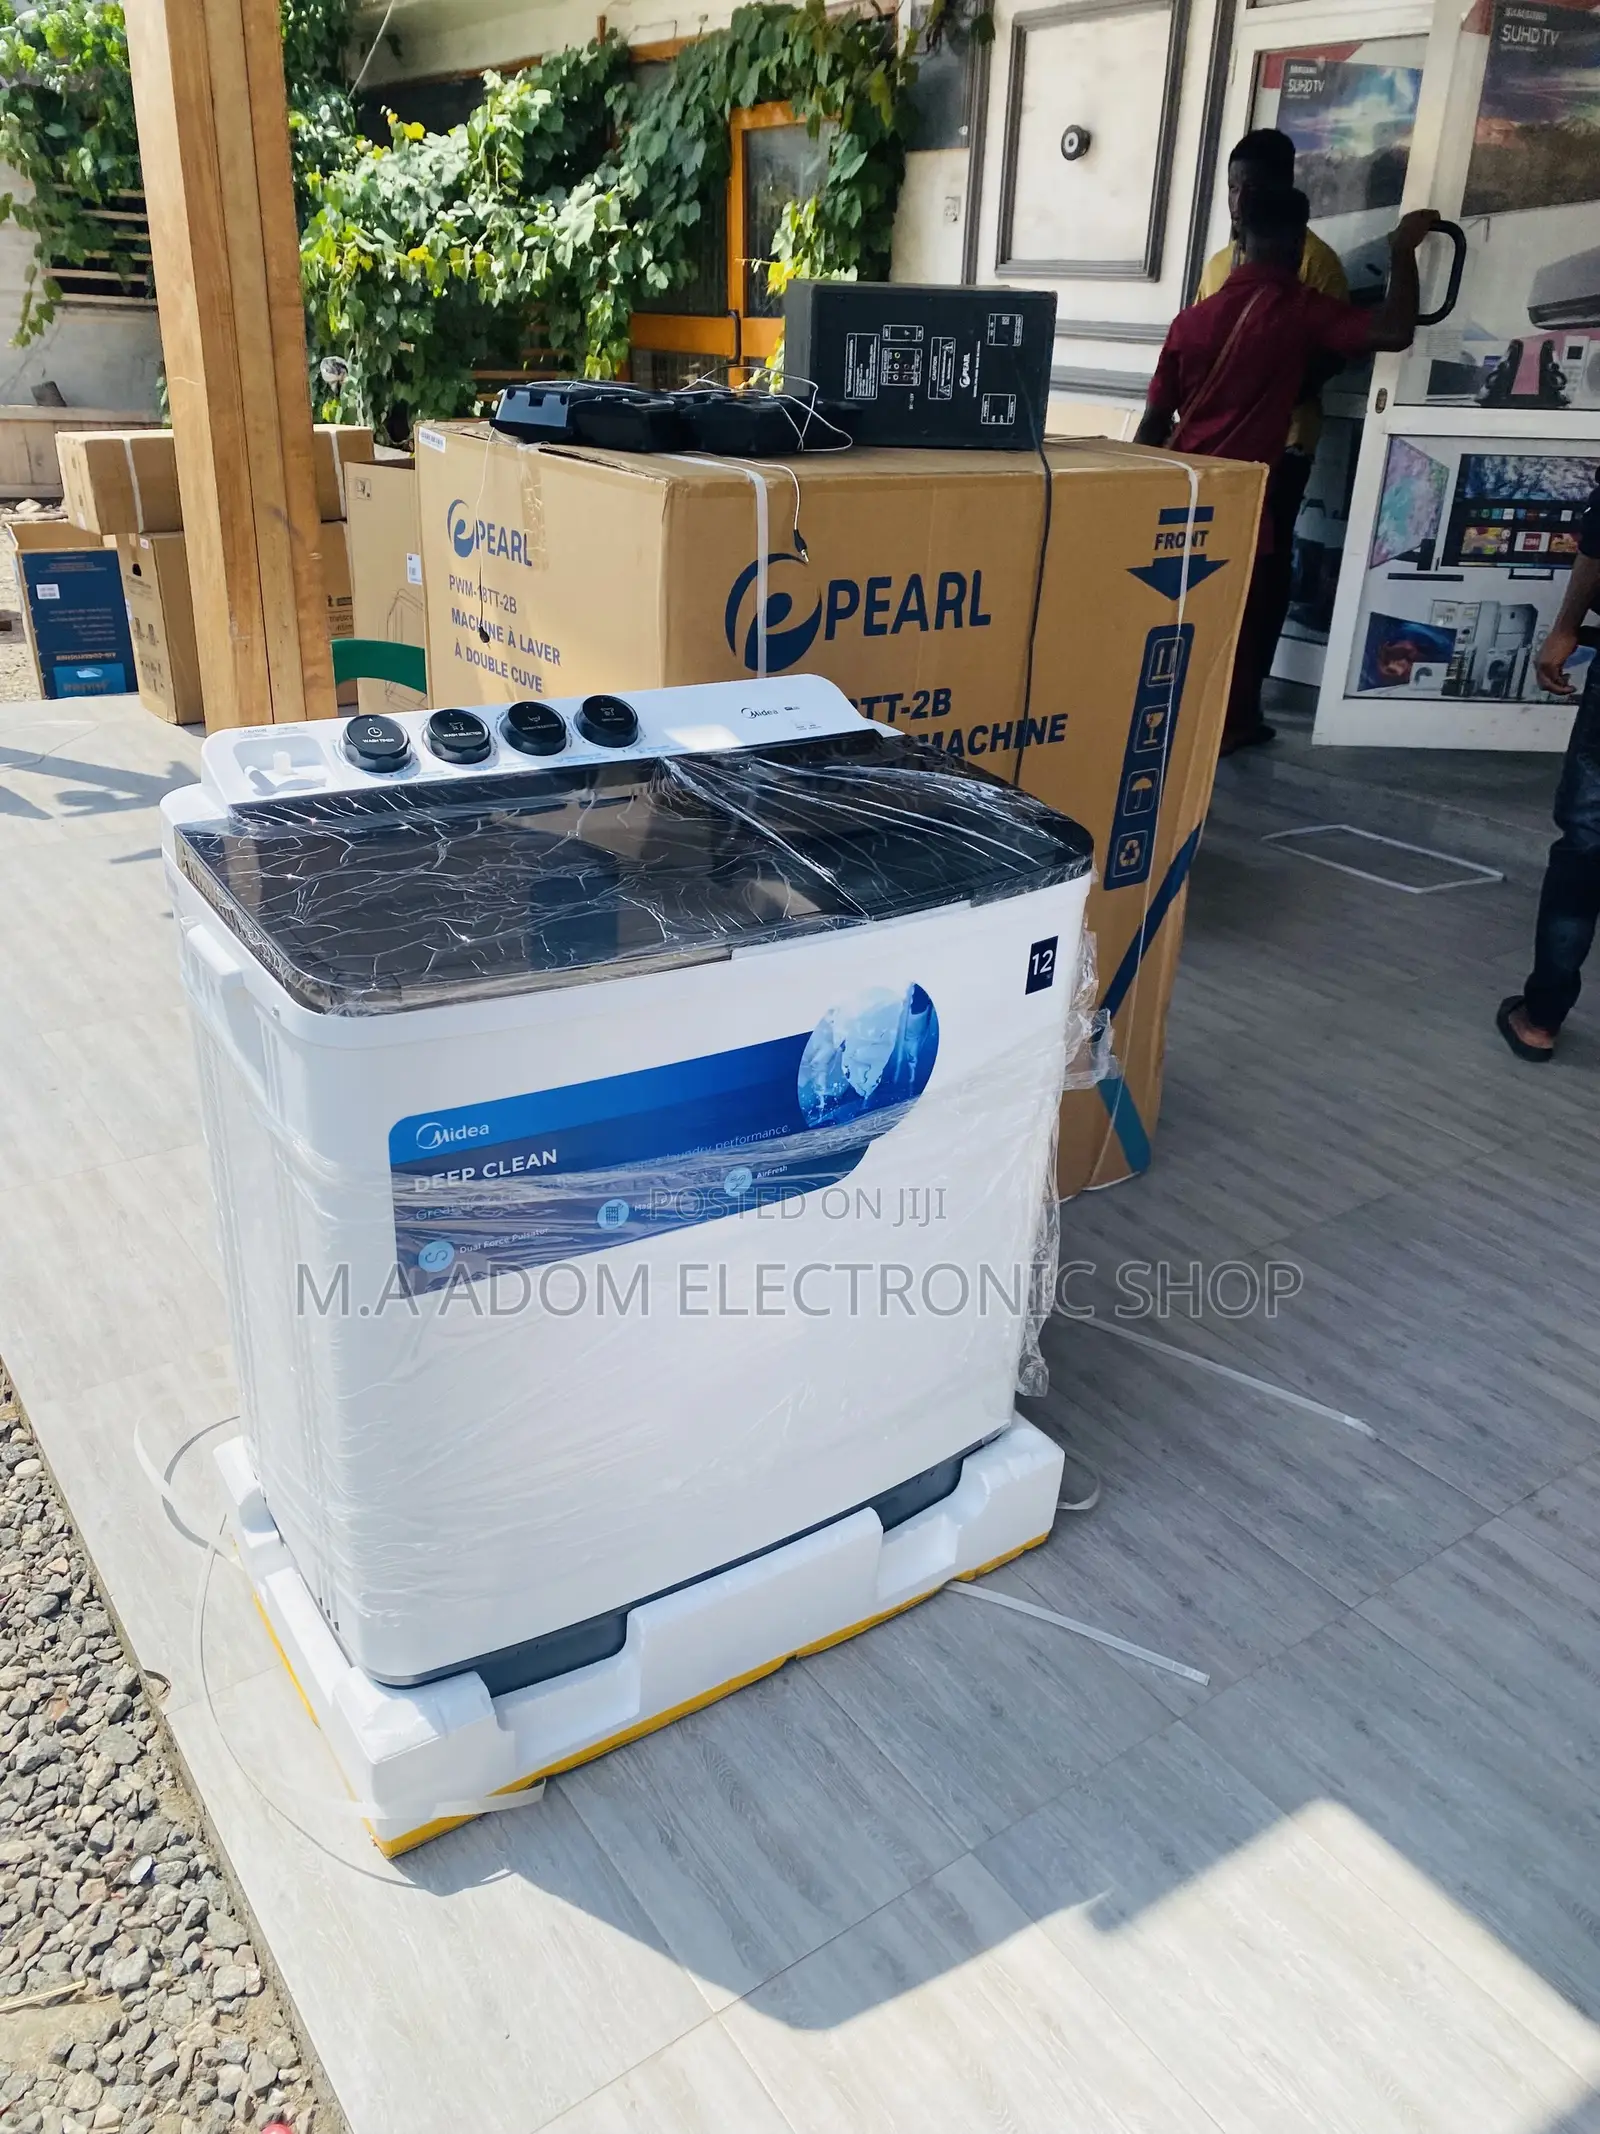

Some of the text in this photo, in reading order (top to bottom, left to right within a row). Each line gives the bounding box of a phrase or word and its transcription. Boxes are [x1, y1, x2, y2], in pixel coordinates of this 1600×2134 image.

[1501, 24, 1560, 46] SUHD TV
[1314, 79, 1326, 93] TV
[476, 519, 533, 567] PEARL
[1154, 530, 1210, 551] FRONT
[824, 569, 992, 641] PEARL
[507, 625, 517, 648] À
[520, 634, 562, 666] LAVER
[455, 638, 543, 693] À DOUBLE CUVE
[741, 707, 779, 719] Midea
[849, 688, 952, 723] TT-2B
[917, 713, 1069, 758] MACHINE
[1032, 949, 1054, 976] 12
[416, 1122, 490, 1150] Midea
[715, 1124, 791, 1151] performance.
[414, 1149, 557, 1192] DEEP CLEAN
[756, 1165, 788, 1179] AirFresh
[459, 1243, 481, 1254] Dual
